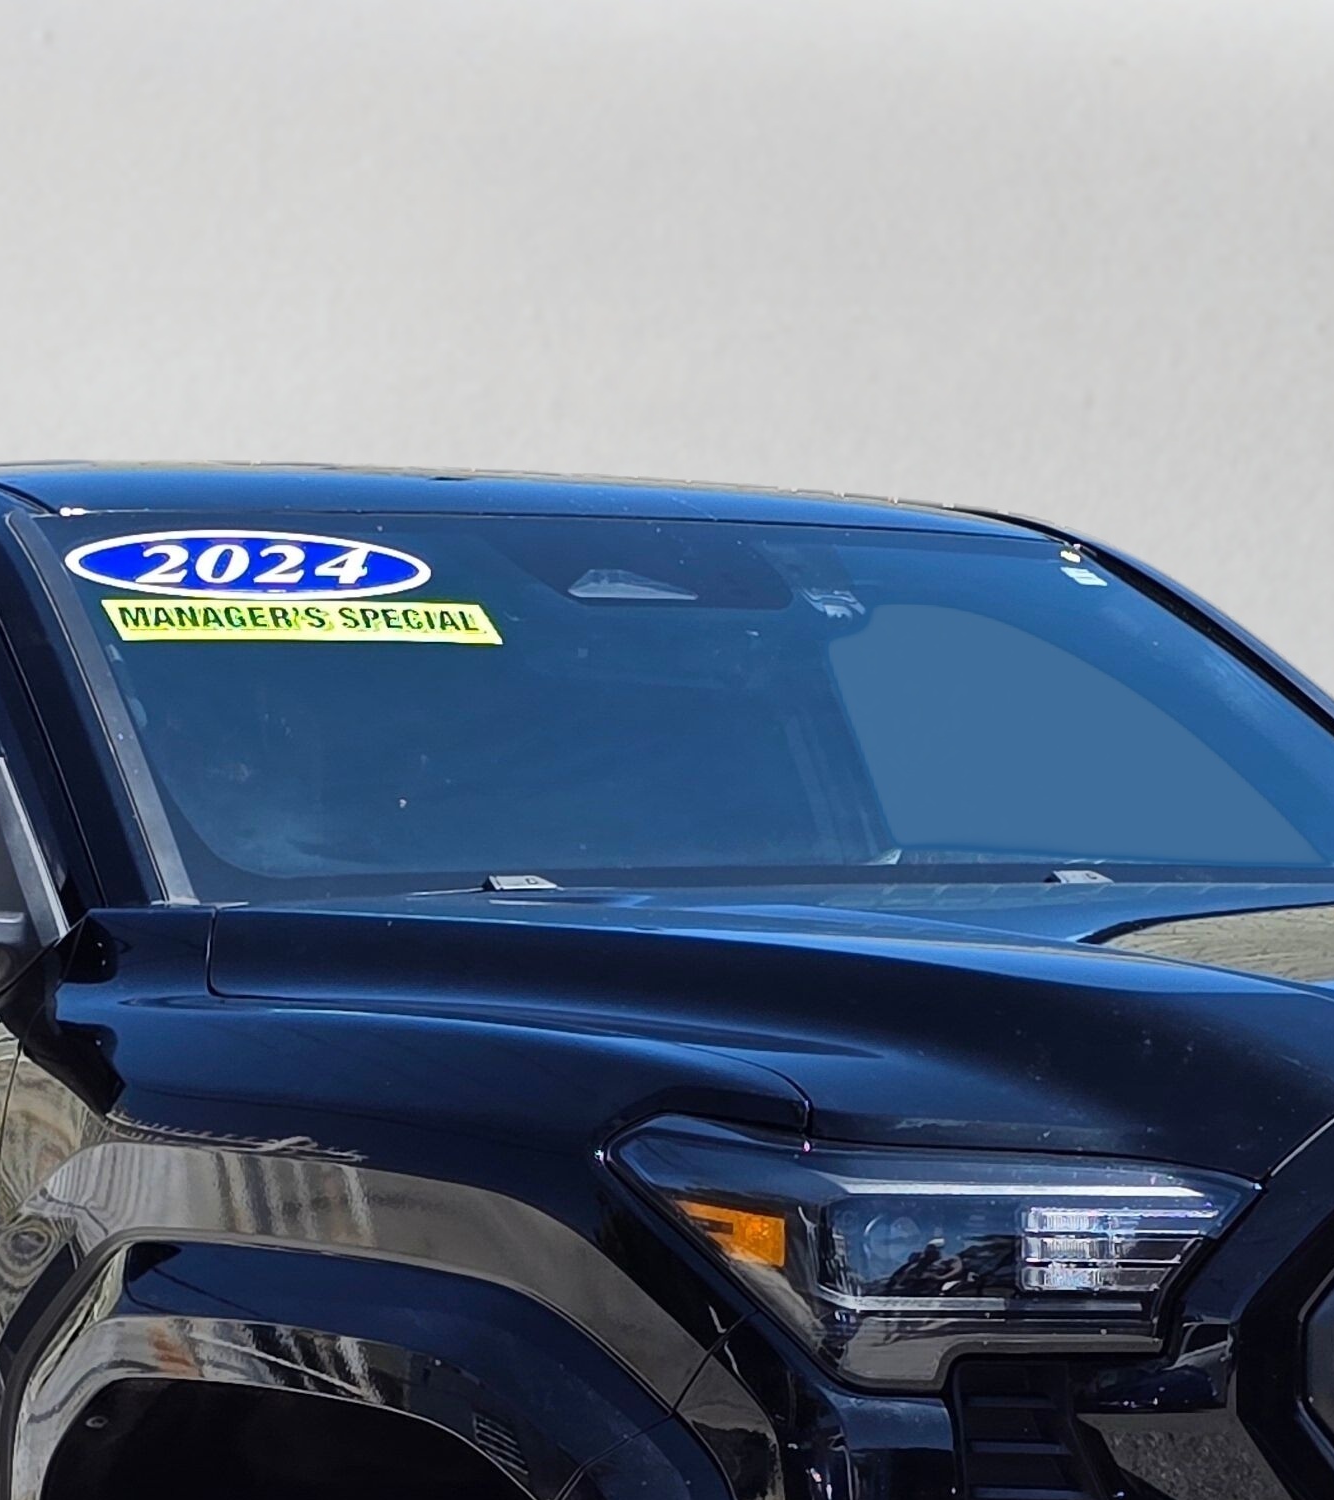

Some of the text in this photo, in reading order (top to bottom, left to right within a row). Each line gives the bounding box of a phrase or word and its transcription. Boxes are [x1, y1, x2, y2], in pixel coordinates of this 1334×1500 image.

[134, 543, 370, 585] 2024
[117, 605, 482, 632] MANAGER'S SPECIAL
